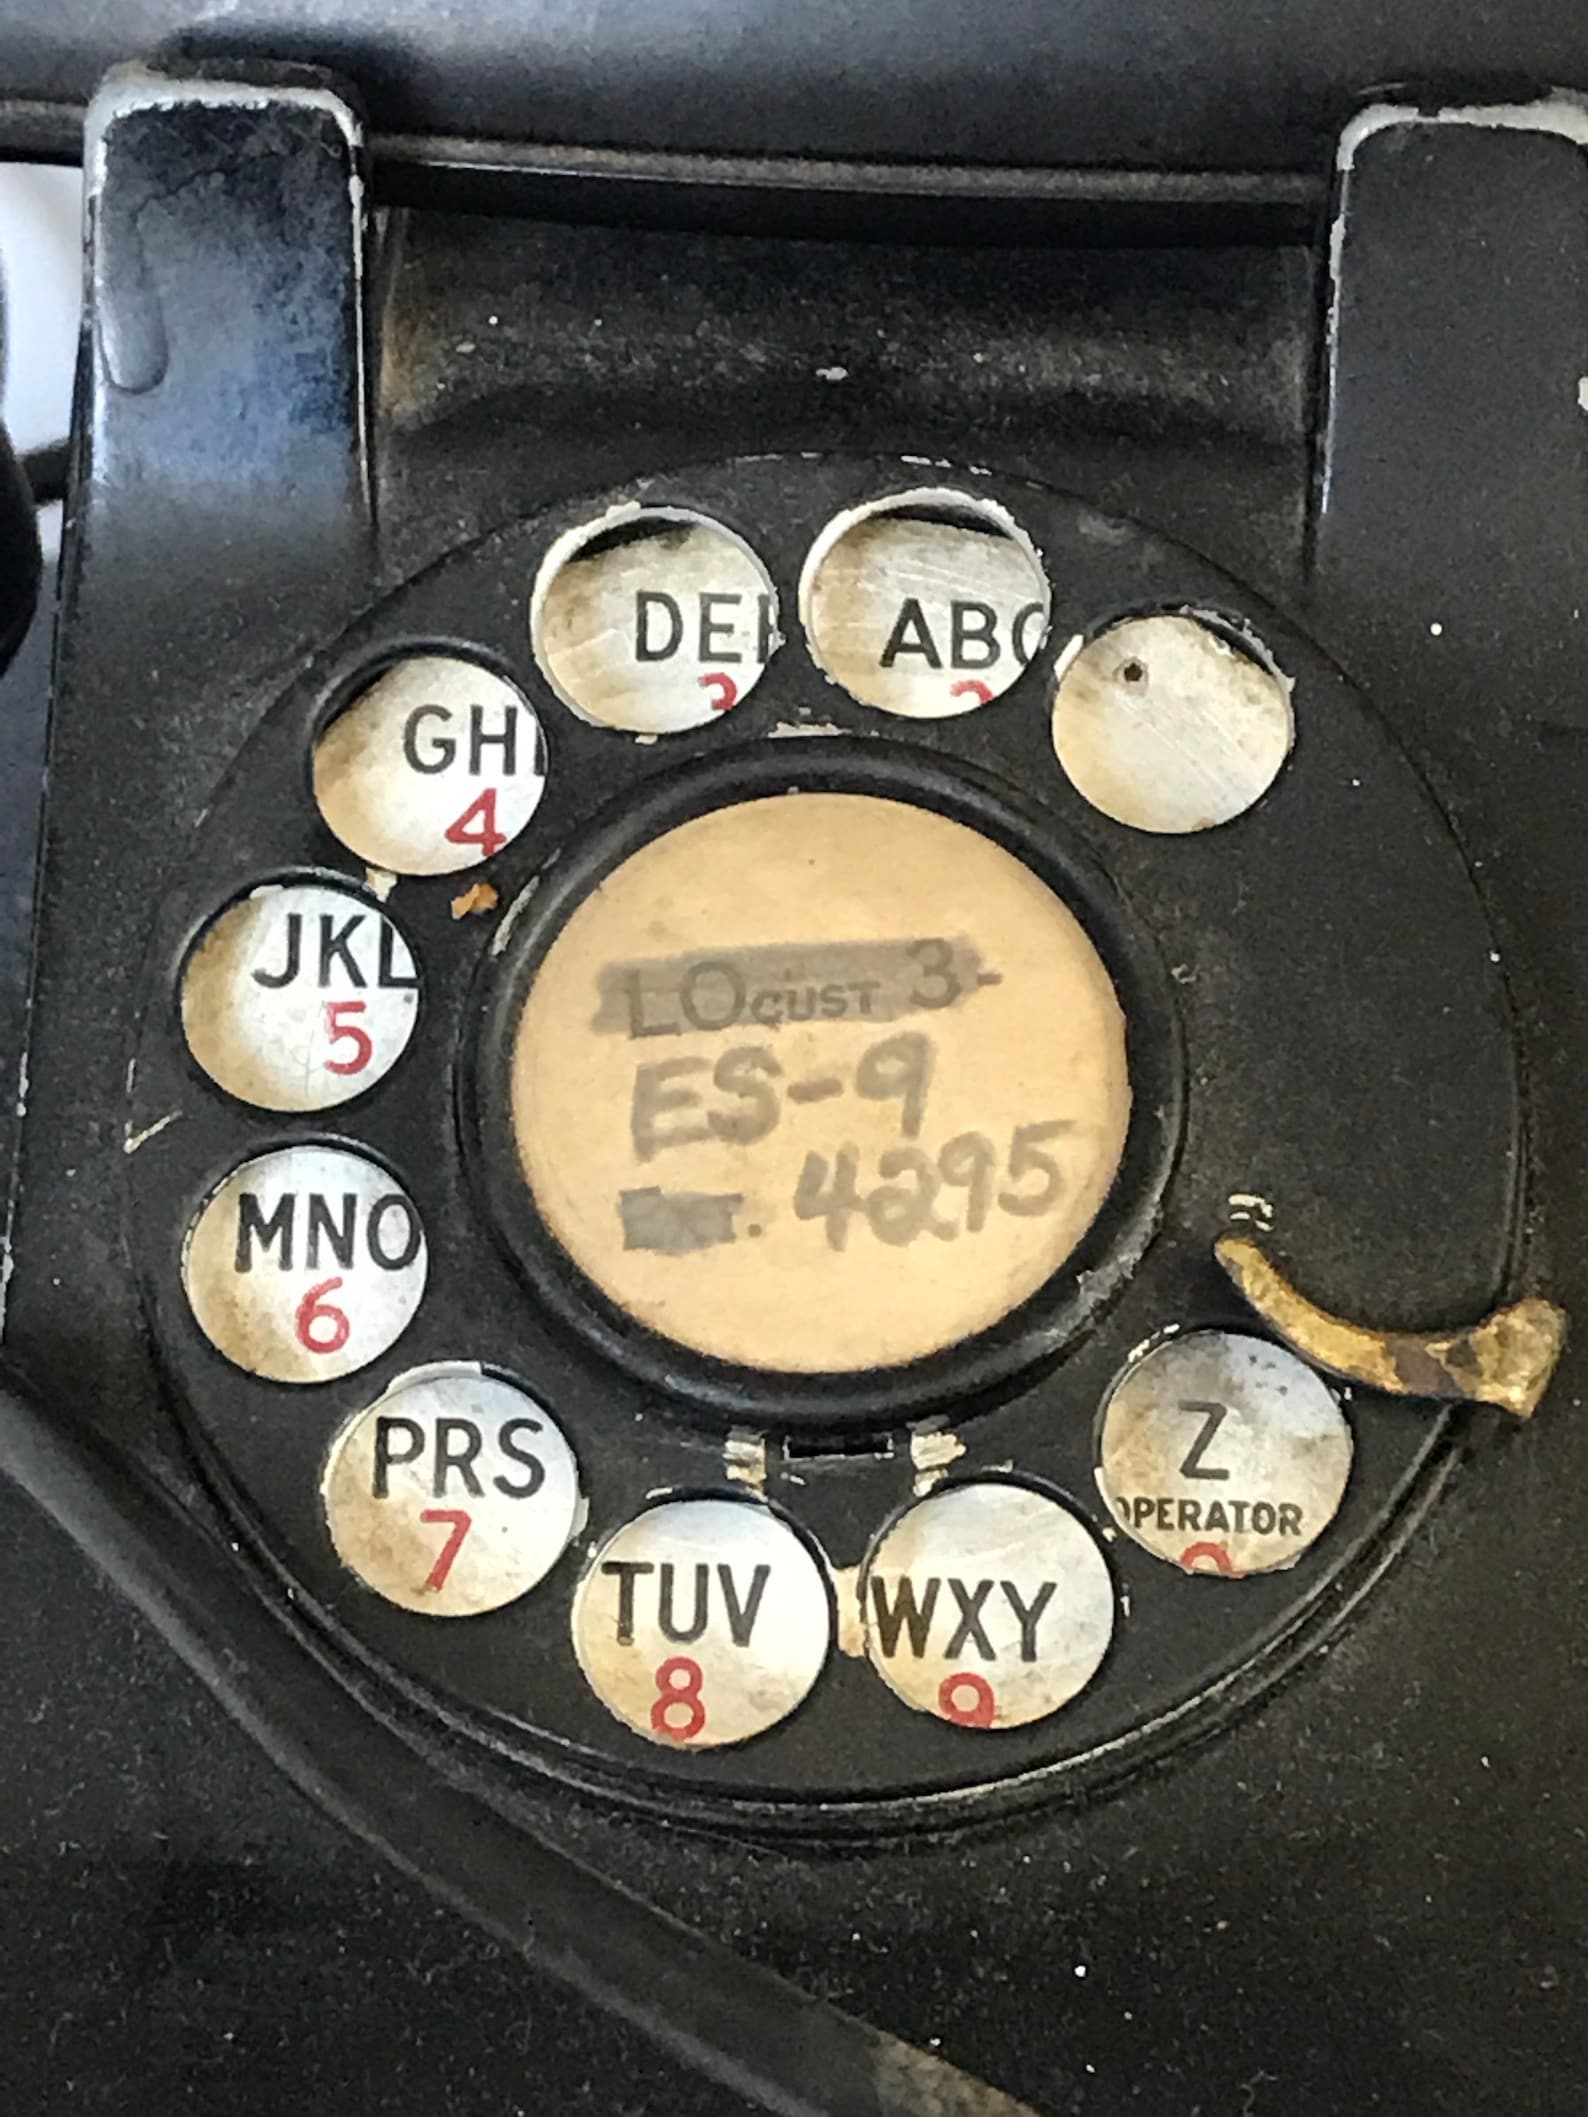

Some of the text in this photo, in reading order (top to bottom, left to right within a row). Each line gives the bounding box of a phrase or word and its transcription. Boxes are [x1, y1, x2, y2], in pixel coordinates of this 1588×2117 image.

[444, 787, 507, 857] 4
[252, 913, 419, 989] JKL
[324, 1000, 373, 1076] 5
[630, 1031, 934, 1162] ES-9
[793, 1119, 1077, 1252] 4295
[234, 1193, 421, 1274] MNO
[295, 1276, 351, 1354] 6
[372, 1416, 546, 1499] PRS
[1178, 1401, 1230, 1480] Z
[419, 1509, 473, 1592] 7
[600, 1561, 771, 1647] TUV
[870, 1575, 1058, 1663] WXY
[650, 1657, 704, 1742] 8
